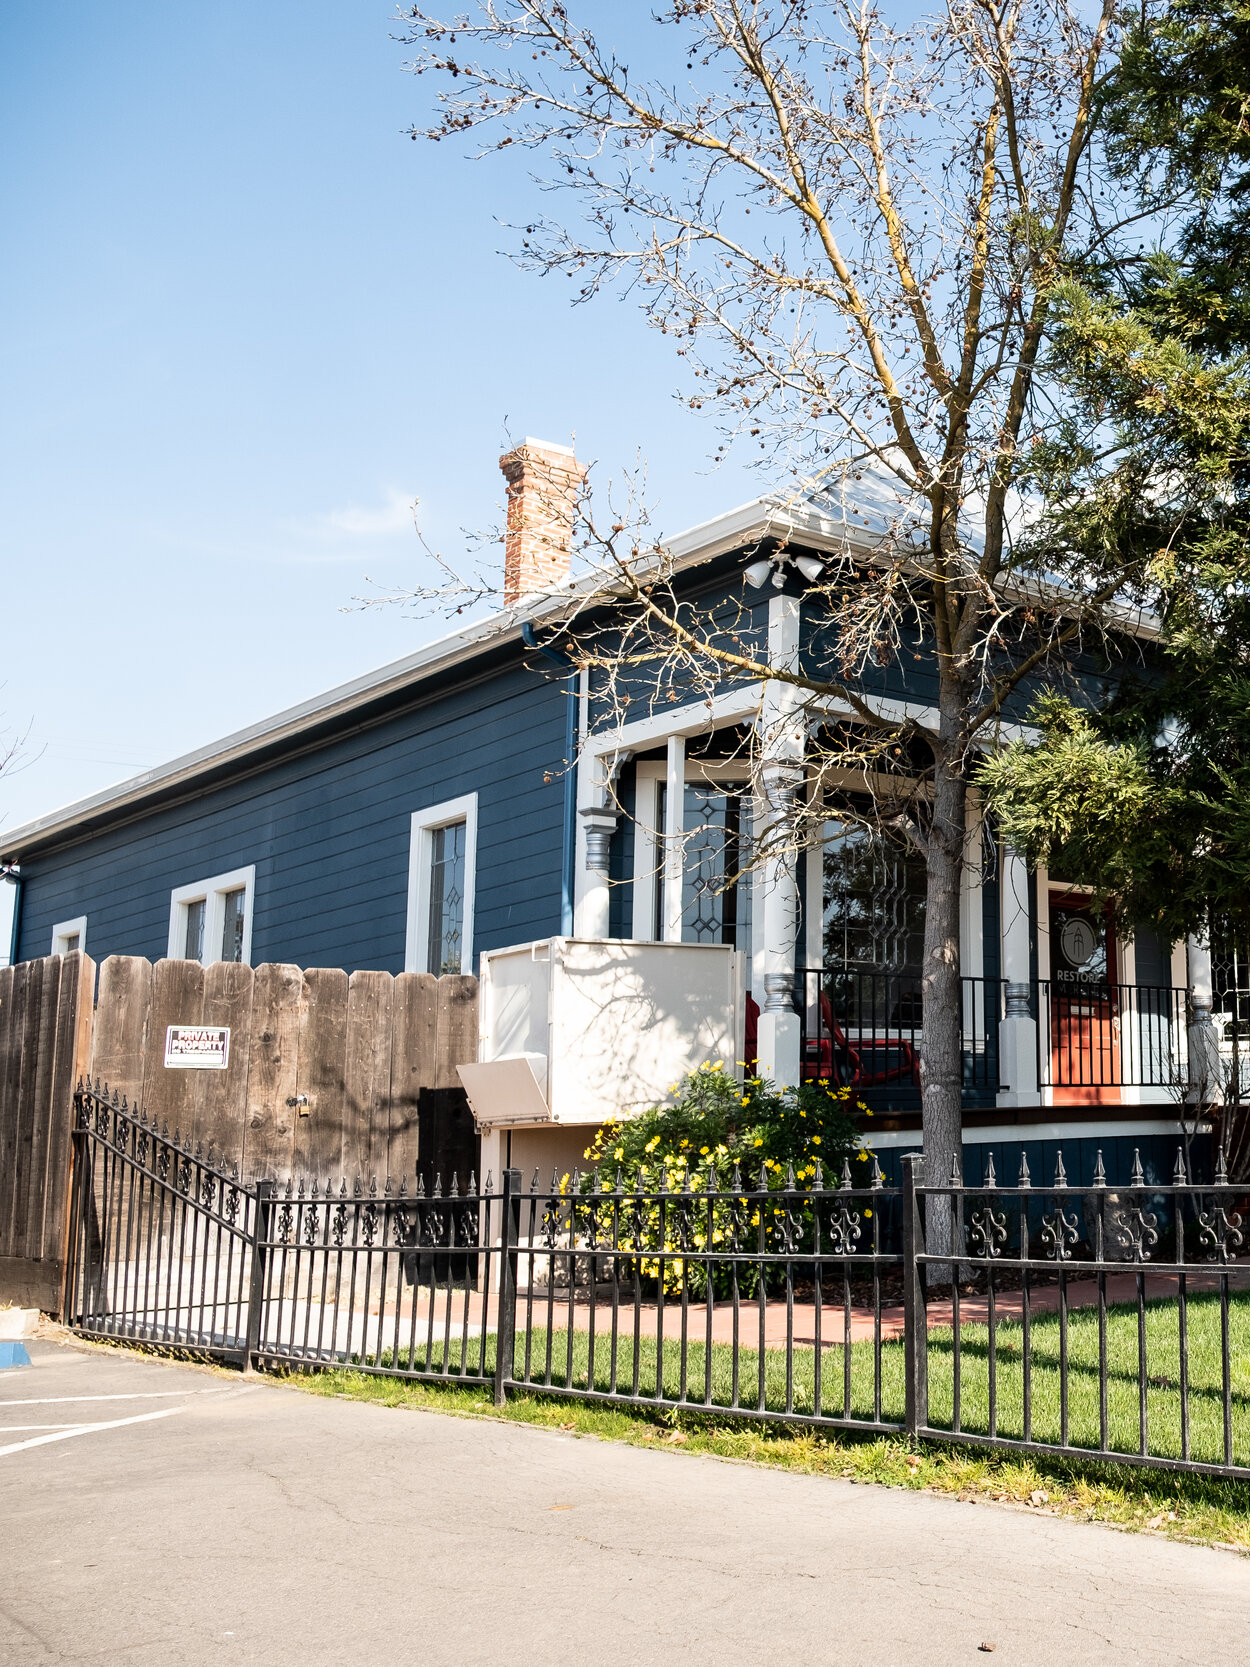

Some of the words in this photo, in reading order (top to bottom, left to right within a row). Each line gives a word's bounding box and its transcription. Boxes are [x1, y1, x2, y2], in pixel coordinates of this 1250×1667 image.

[1057, 969, 1101, 983] RESTORE
[178, 1031, 220, 1041] PRIVATE
[172, 1040, 224, 1050] PROPERTY
